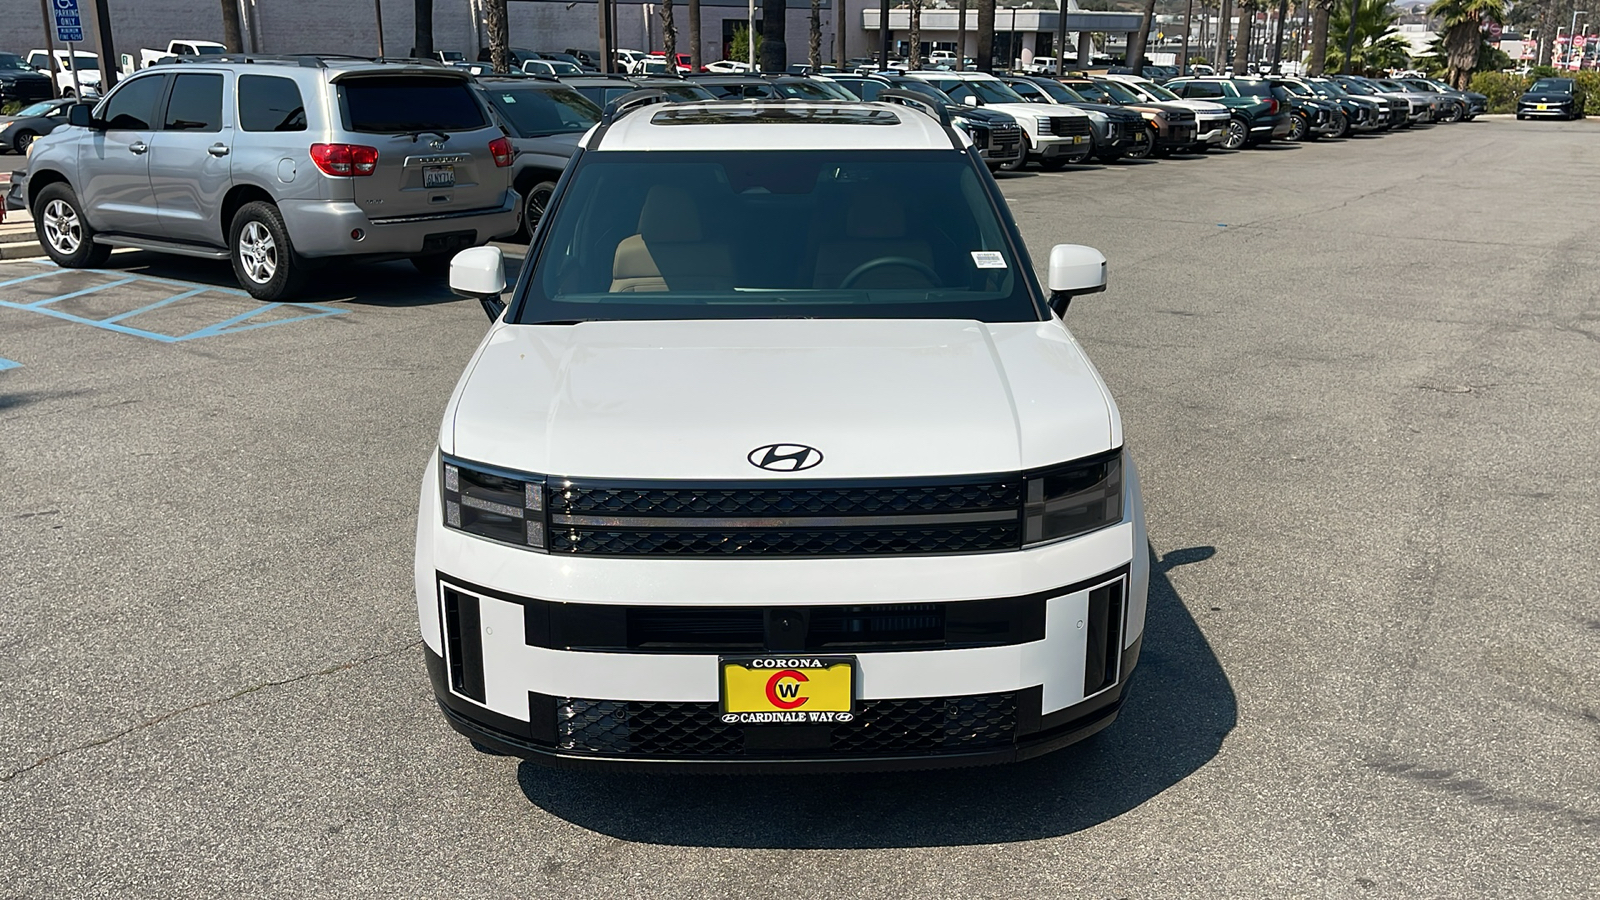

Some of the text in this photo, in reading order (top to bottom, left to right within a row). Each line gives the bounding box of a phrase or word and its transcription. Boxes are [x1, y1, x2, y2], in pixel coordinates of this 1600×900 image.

[55, 9, 79, 17] PARKING
[752, 658, 822, 668] CORONA
[740, 712, 836, 723] CARDINALE WAY
